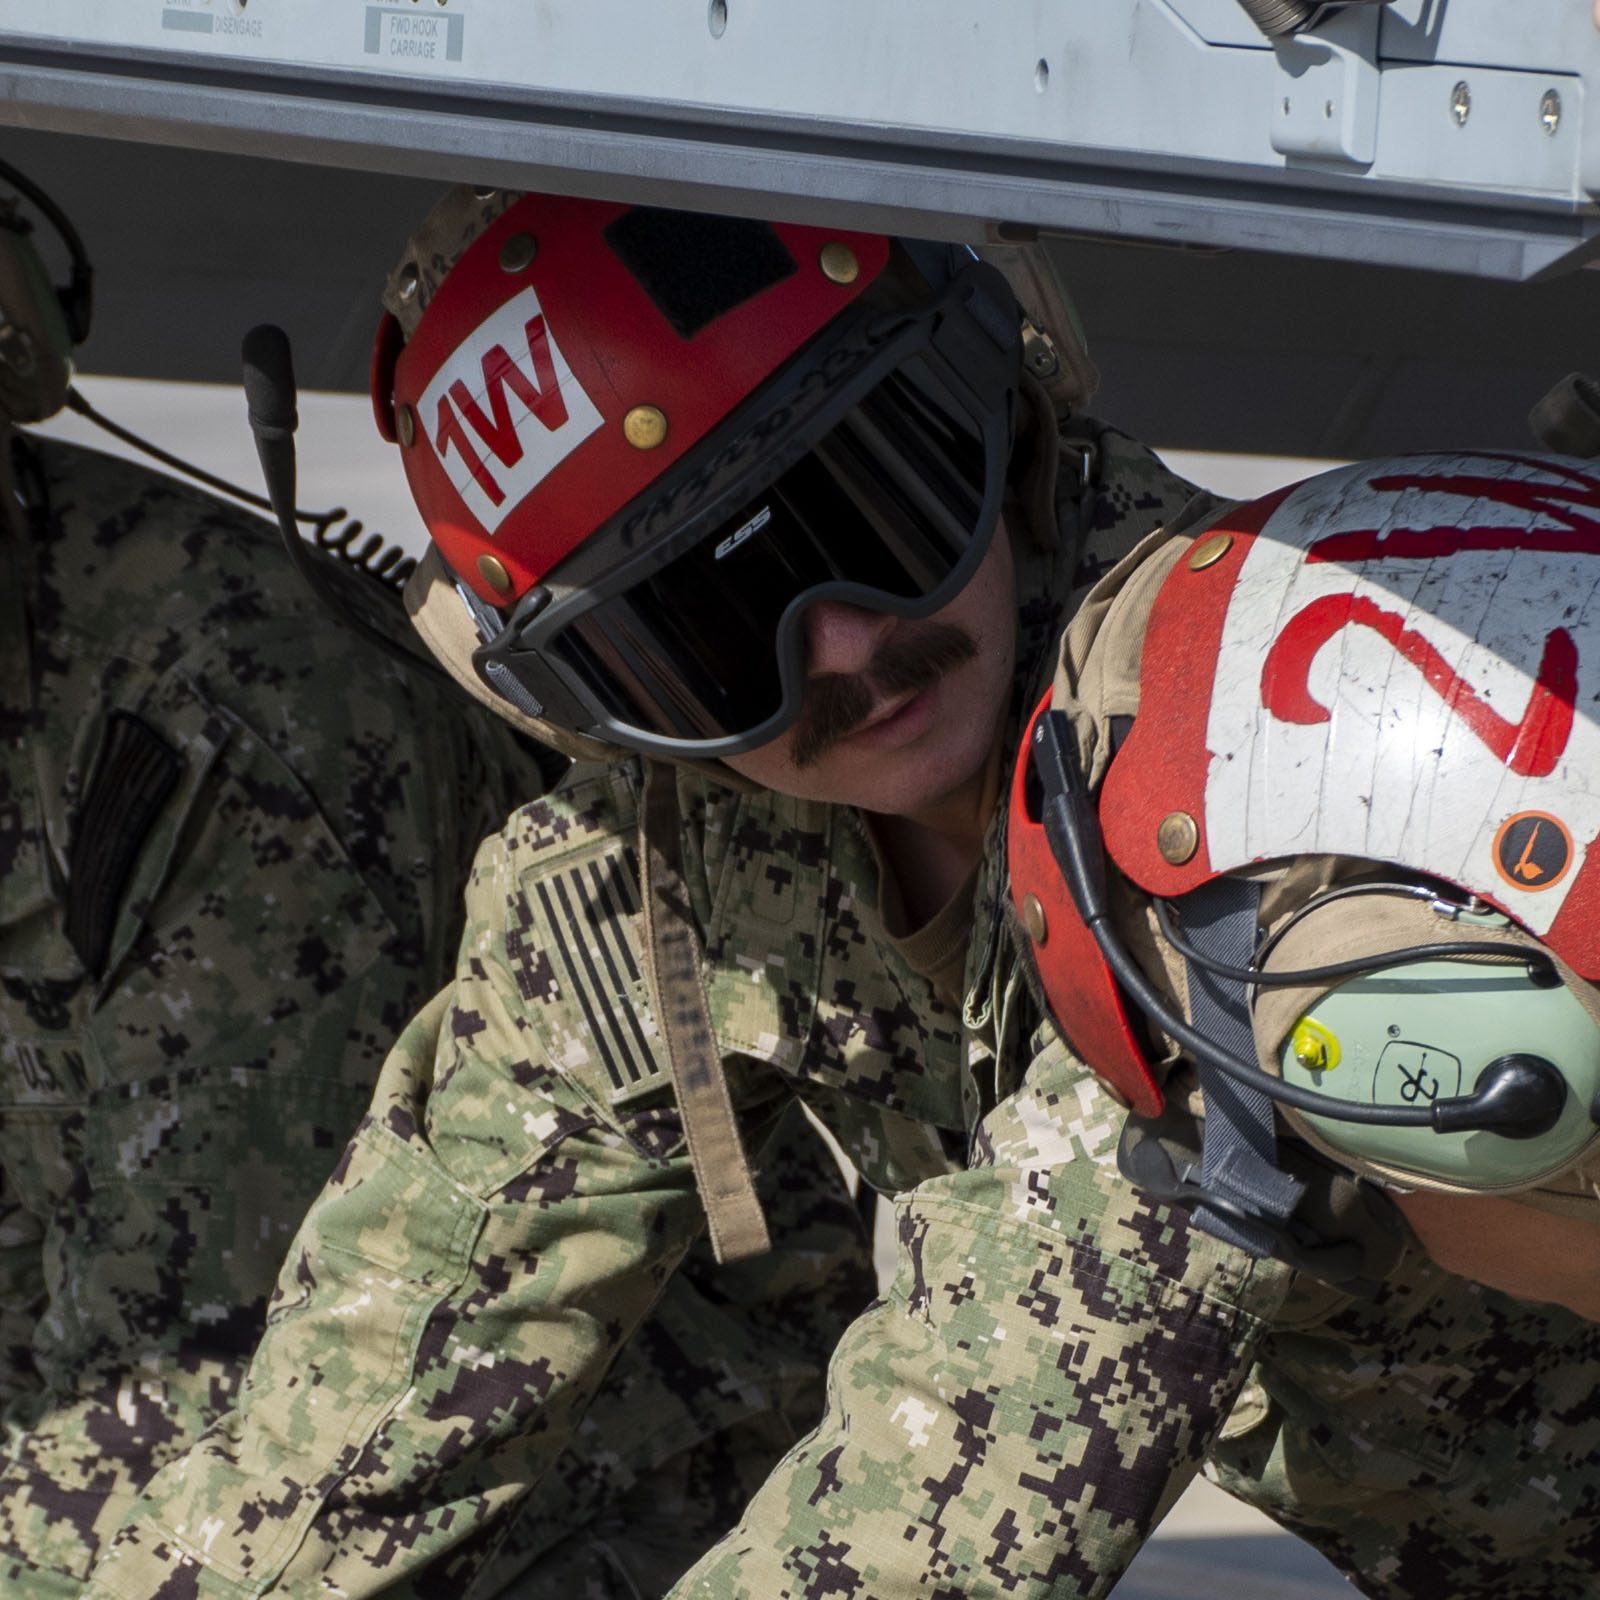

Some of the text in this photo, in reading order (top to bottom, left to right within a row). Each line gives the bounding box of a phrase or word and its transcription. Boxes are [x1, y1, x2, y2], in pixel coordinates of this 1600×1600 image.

[215, 16, 263, 37] DISENGAGE
[390, 16, 438, 37] FWD HOOK
[390, 38, 436, 59] CARRIAGE
[436, 313, 569, 507] 1W
[714, 504, 772, 560] ESS
